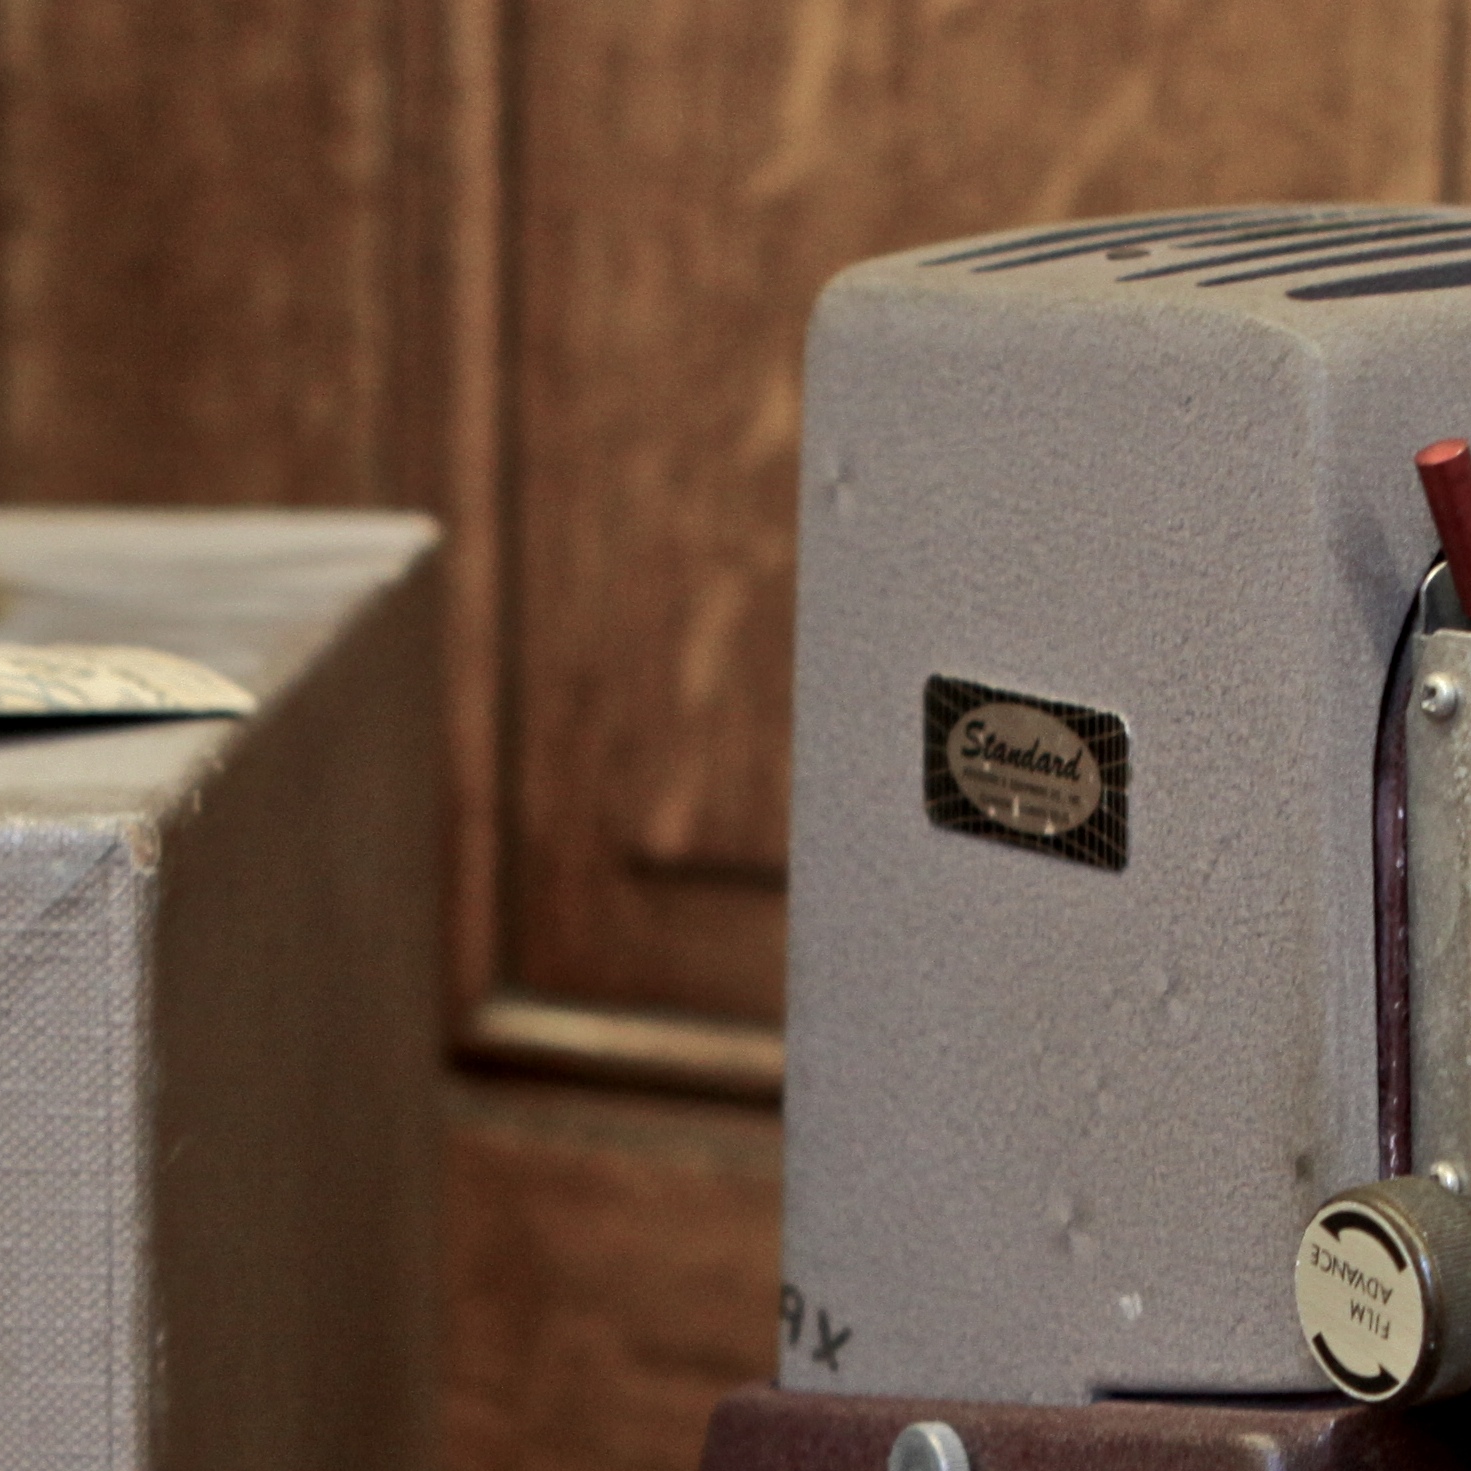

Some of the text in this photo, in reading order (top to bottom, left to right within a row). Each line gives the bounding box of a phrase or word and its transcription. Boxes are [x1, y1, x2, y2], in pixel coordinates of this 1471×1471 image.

[961, 720, 1083, 781] Standard
[1310, 1243, 1393, 1305] ADVANCE
[1350, 1299, 1391, 1340] FILM
